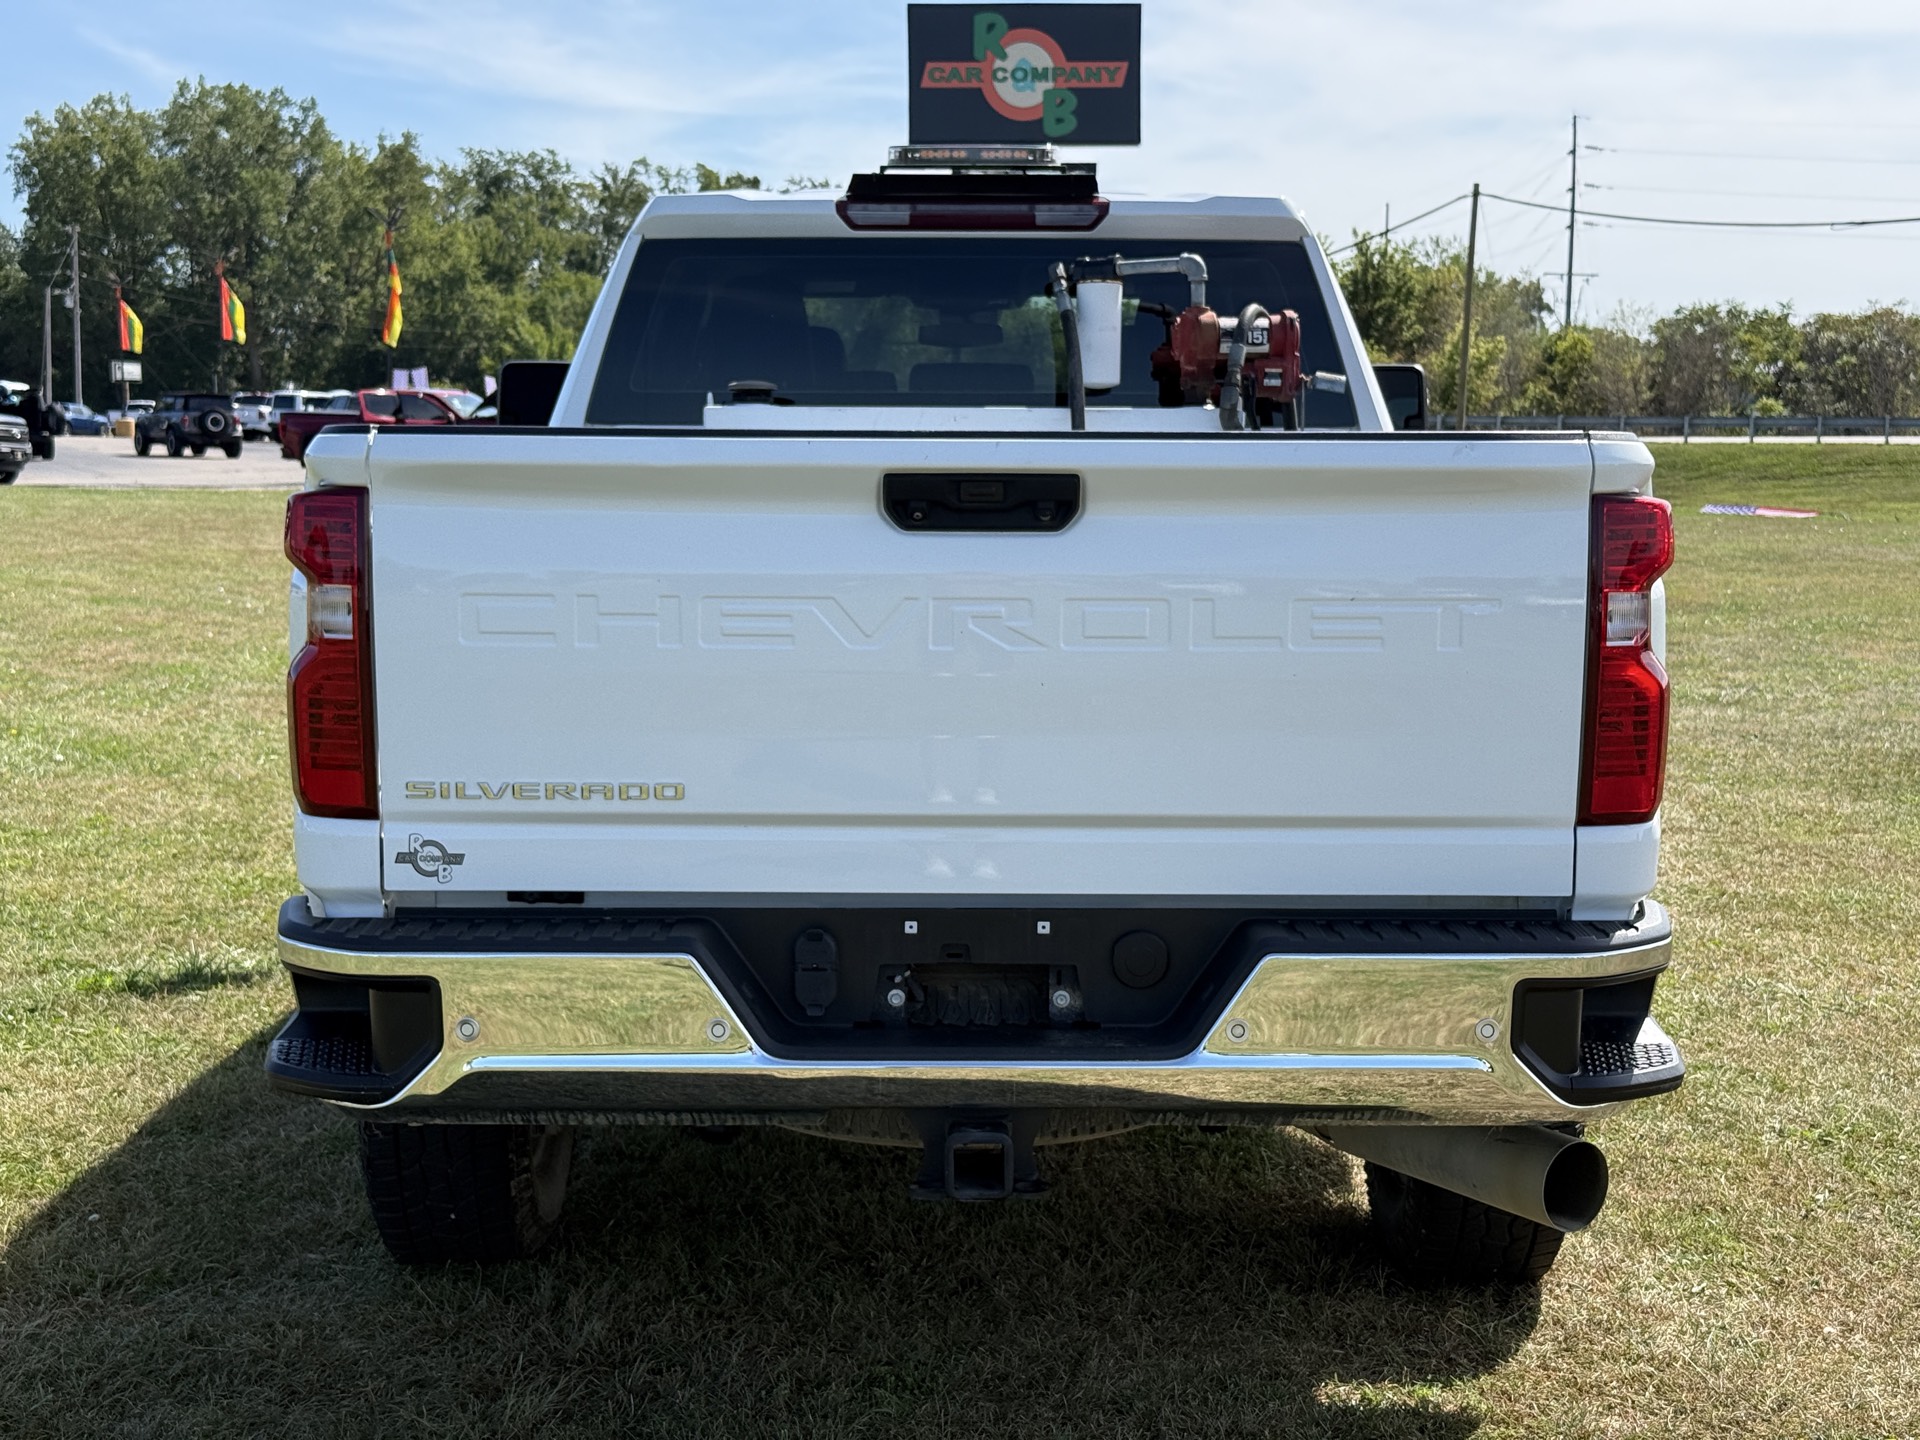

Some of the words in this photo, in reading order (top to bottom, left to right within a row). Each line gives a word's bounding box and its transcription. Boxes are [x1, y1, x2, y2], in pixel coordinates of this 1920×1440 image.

[973, 12, 1008, 61] R
[927, 66, 983, 83] CAR
[991, 66, 1122, 84] COMPANY
[1043, 88, 1078, 137] B
[458, 592, 1502, 652] CHEVROLET
[405, 781, 686, 801] SILVERADO
[409, 833, 424, 853] R
[437, 864, 453, 884] B
